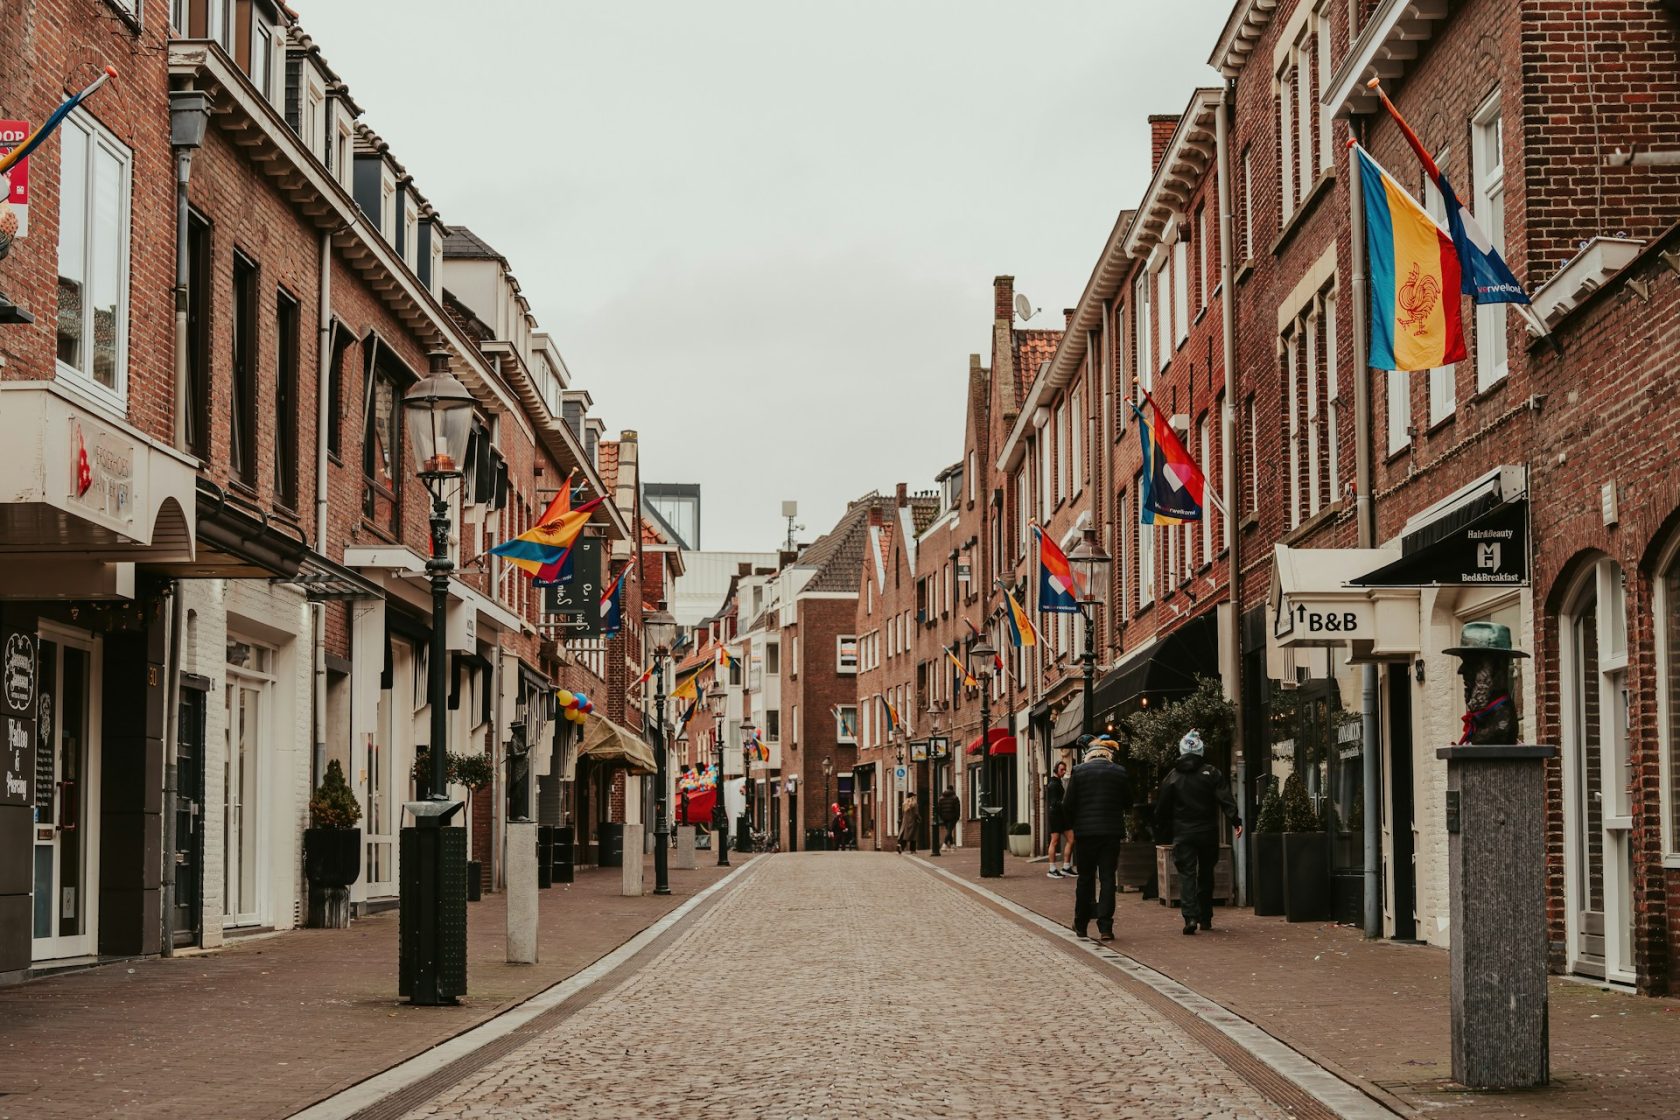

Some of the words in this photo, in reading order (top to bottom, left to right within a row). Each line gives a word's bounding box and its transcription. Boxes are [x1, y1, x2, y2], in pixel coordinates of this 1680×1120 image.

[0, 130, 25, 142] OP
[1467, 529, 1514, 539] Hair&Beauty
[1461, 572, 1519, 582] Bed&Breakfast
[1309, 612, 1358, 632] B&B
[8, 718, 28, 751] Tattoo
[6, 770, 27, 801] Piercing
